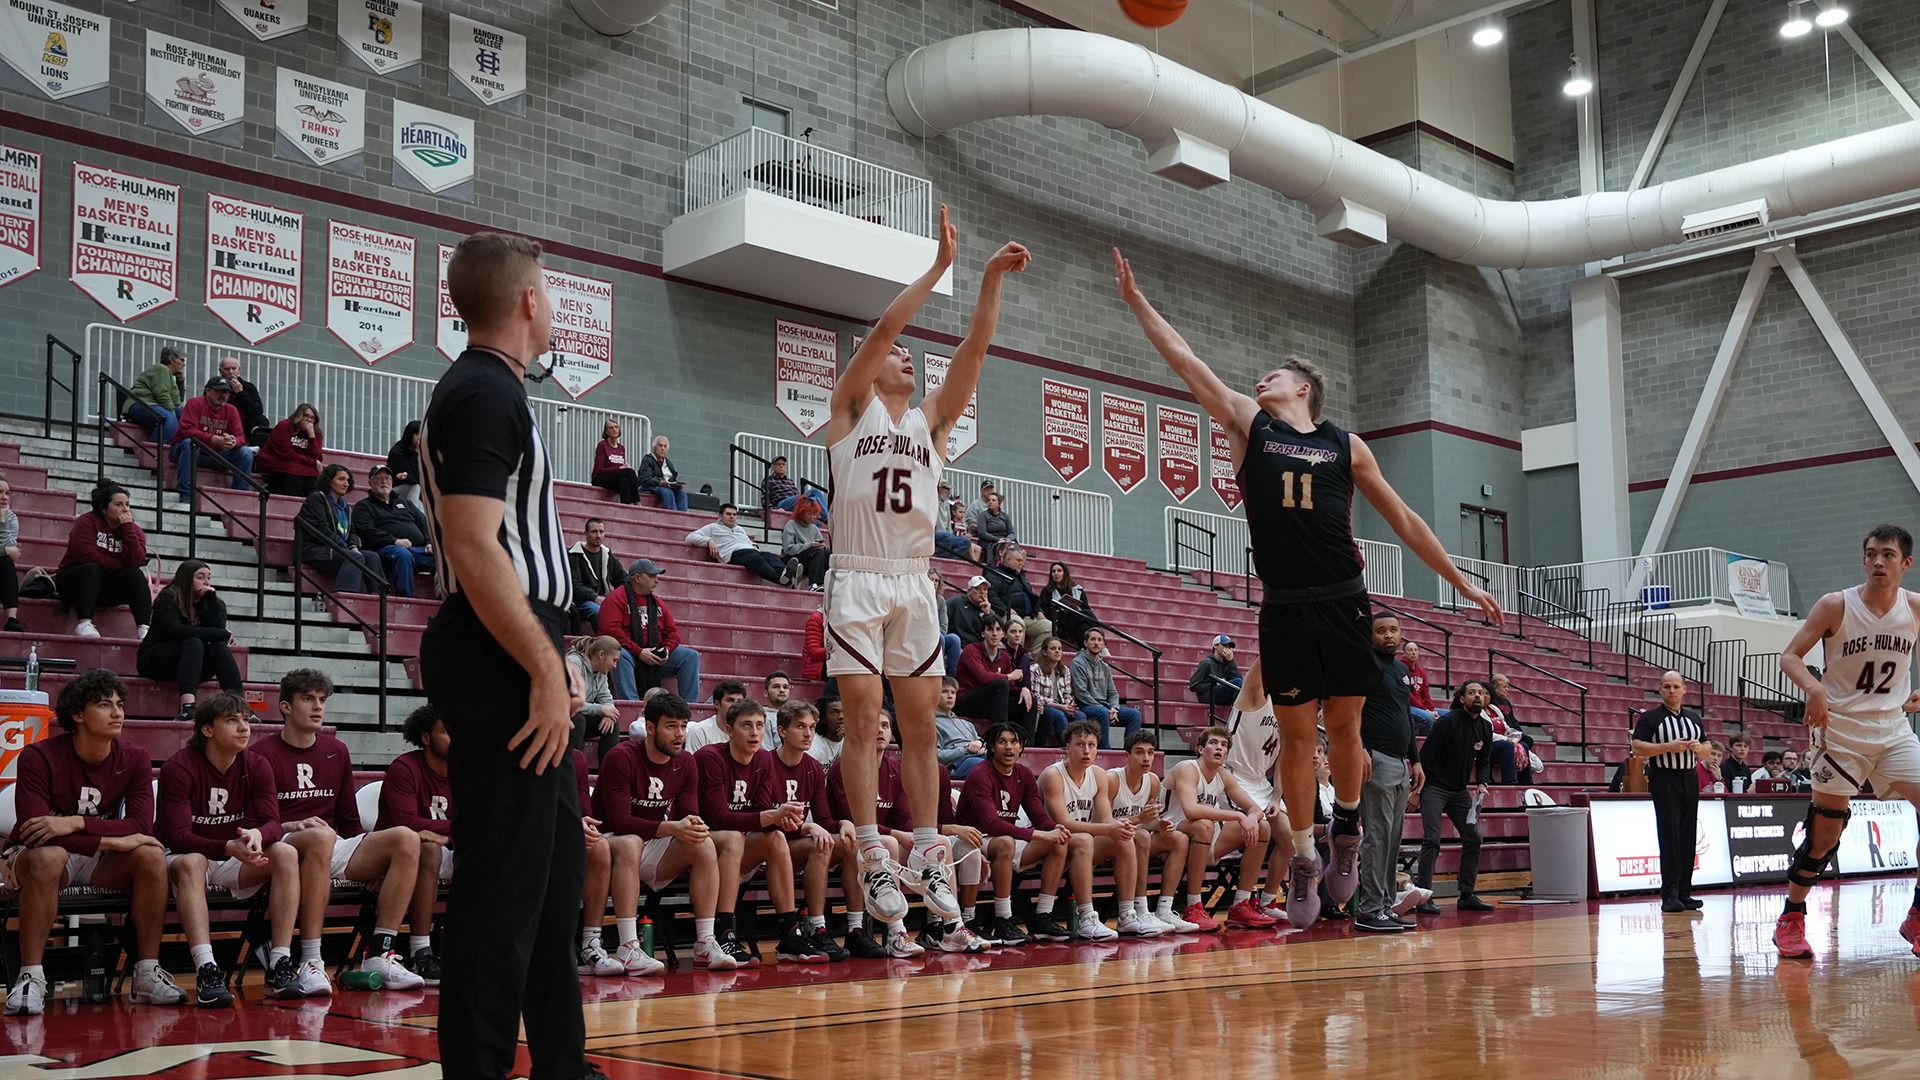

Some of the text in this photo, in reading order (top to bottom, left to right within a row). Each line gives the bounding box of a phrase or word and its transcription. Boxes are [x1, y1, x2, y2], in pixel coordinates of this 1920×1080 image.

[10, 0, 99, 31] MOUNT ST. JOSEPH
[243, 7, 281, 25] QUAKERS
[365, 1, 396, 17] COLLEGE
[27, 13, 82, 35] UNIVERSITY
[473, 27, 504, 43] HANOVER
[474, 36, 502, 51] COLLEGE
[41, 53, 68, 67] MSJ
[166, 43, 226, 67] ROSE-HULMAN
[361, 43, 399, 60] GRIZZLIES
[41, 65, 69, 80] LIONS
[150, 48, 241, 79] INSTITUTE OF TECHNOLOGY
[293, 78, 349, 101] TRANSYLVANIA
[470, 75, 505, 91] PANTHERS
[299, 88, 343, 107] UNIVERSITY
[192, 105, 225, 121] ENGINEERS
[301, 119, 341, 137] TRANSY
[301, 133, 339, 150] PIONEERS
[401, 127, 467, 159] HEARTLAND
[77, 170, 175, 203] ROSE-HULMAN
[104, 197, 149, 217] MEN'S
[212, 200, 299, 230] ROSE-HULMAN
[77, 205, 173, 236] BASKETBALL
[80, 221, 171, 252] Heartland
[235, 226, 276, 244] MEN'S
[332, 226, 412, 251] ROSE-HULMAN
[211, 233, 298, 262] BASKETBALL
[78, 245, 172, 271] TOURNAMENT
[213, 249, 295, 277] Heartland
[354, 250, 391, 267] MEN'S
[78, 255, 172, 287] CHAMPIONS
[332, 257, 411, 283] BASKETBALL
[212, 273, 296, 310] CHAMPIONS
[334, 272, 410, 295] REGULAR SEASON
[545, 275, 610, 298] OSE-HULMAN
[136, 297, 160, 310] 2013
[333, 281, 411, 308] CHAMPIONS
[344, 299, 401, 317] Heartland
[560, 298, 592, 315] MEN'S
[265, 320, 285, 333] 2013
[359, 321, 383, 332] 2014
[552, 311, 611, 333] ASKETBALL
[551, 327, 607, 346] EGULAR SEASON
[778, 324, 835, 344] ROSE-HULMAN
[778, 341, 835, 362] VOLLEYBALL
[552, 353, 600, 371] Heartland
[783, 359, 829, 376] TOURNAMENT
[779, 368, 833, 388] CHAMPIONS
[787, 388, 827, 403] Heartland
[1045, 383, 1088, 399] ROSE-HULMAN
[800, 408, 815, 418] 2018
[1051, 399, 1082, 413] WOMEN'S
[1104, 397, 1144, 413] ROSE-HULMAN
[1045, 406, 1088, 423] BASKETBALL
[1109, 412, 1139, 426] WOMEN'S
[1046, 423, 1088, 441] CHAMPIONS
[1104, 419, 1144, 435] BASKETBALL
[1165, 424, 1192, 437] WOMEN'S
[1105, 436, 1144, 452] CHAMPIONS
[1160, 431, 1197, 446] BASKETBALL
[1162, 442, 1197, 453] TOURNAMENT
[1161, 447, 1197, 462] CHAMPIONS
[1212, 447, 1231, 459] BASKE
[1263, 440, 1337, 463] EARLHAM
[1213, 467, 1235, 478] CHAMP
[872, 467, 912, 514] 15
[1282, 471, 1313, 509] 11
[1855, 661, 1897, 694] 42
[296, 763, 316, 789] R
[277, 789, 334, 800] BASKETBALL
[648, 776, 664, 799] R
[733, 780, 748, 802] R
[786, 780, 798, 802] R
[77, 786, 102, 815] R
[208, 787, 229, 815] R
[1848, 803, 1902, 816] OSE-HULMAN
[1620, 858, 1661, 875] ROSE-HU
[1889, 851, 1909, 867] CLUB
